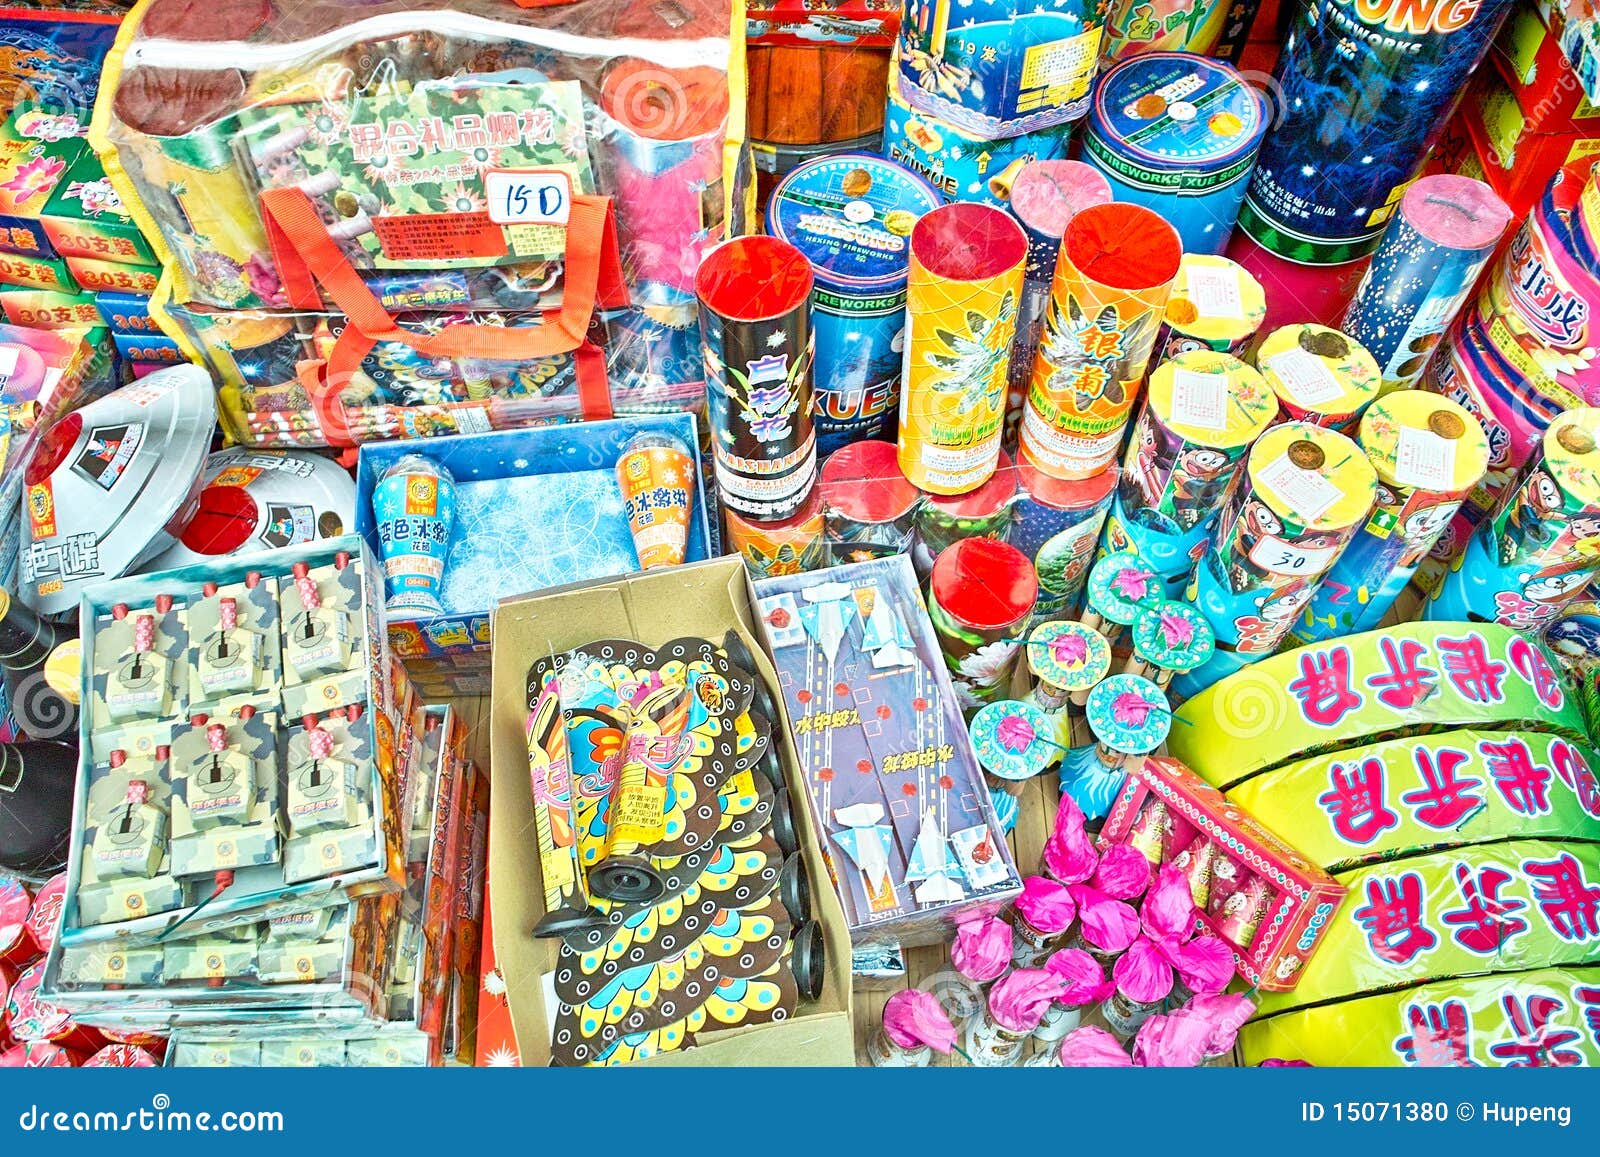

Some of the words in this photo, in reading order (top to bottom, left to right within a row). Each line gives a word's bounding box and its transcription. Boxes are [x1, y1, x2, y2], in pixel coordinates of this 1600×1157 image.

[957, 39, 976, 55] 19
[350, 110, 557, 162] 混合礼品烟花
[1101, 151, 1182, 185] FIREWORKS
[1272, 551, 1305, 568] 30
